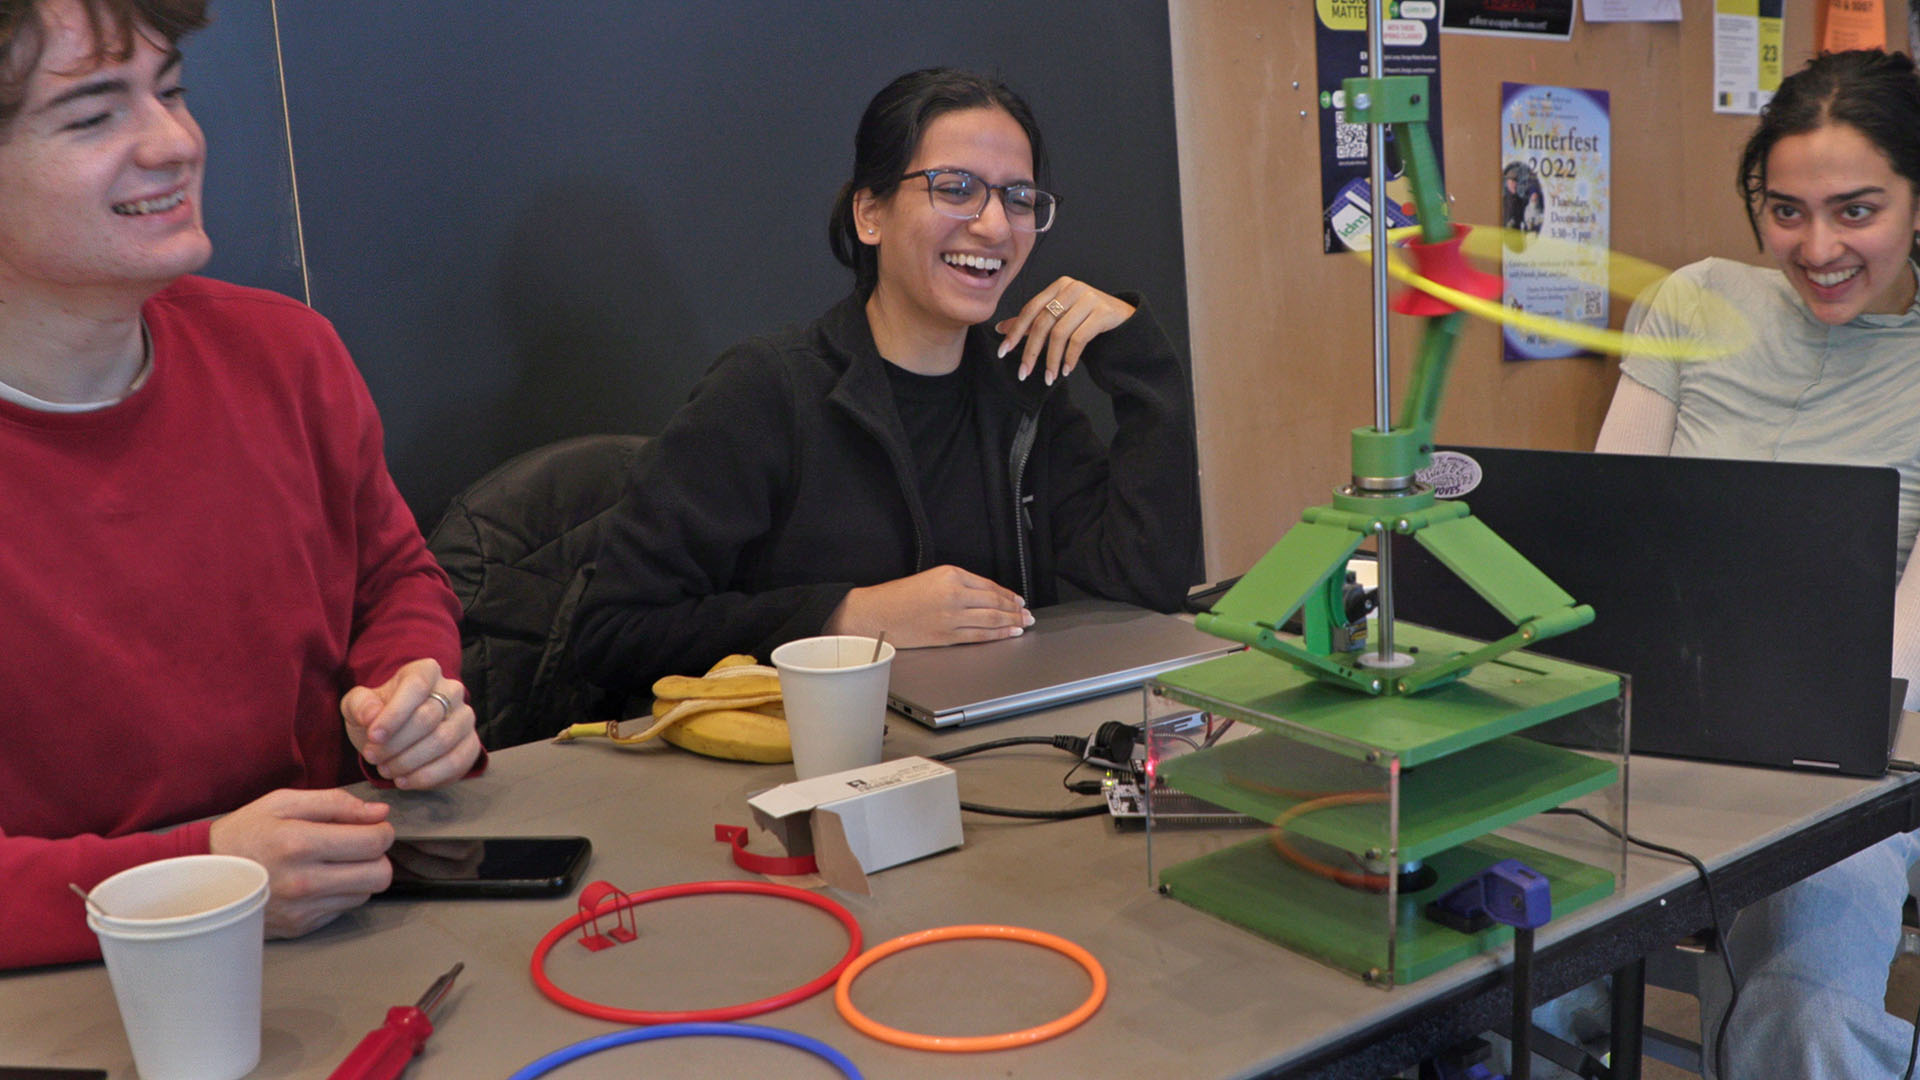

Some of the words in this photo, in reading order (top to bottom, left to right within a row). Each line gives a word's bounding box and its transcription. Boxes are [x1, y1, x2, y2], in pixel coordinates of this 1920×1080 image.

[1332, 5, 1368, 19] MATTE
[1763, 44, 1778, 62] 23
[1510, 122, 1599, 152] Winterfest
[1528, 156, 1577, 178] 2022
[1551, 211, 1590, 222] December
